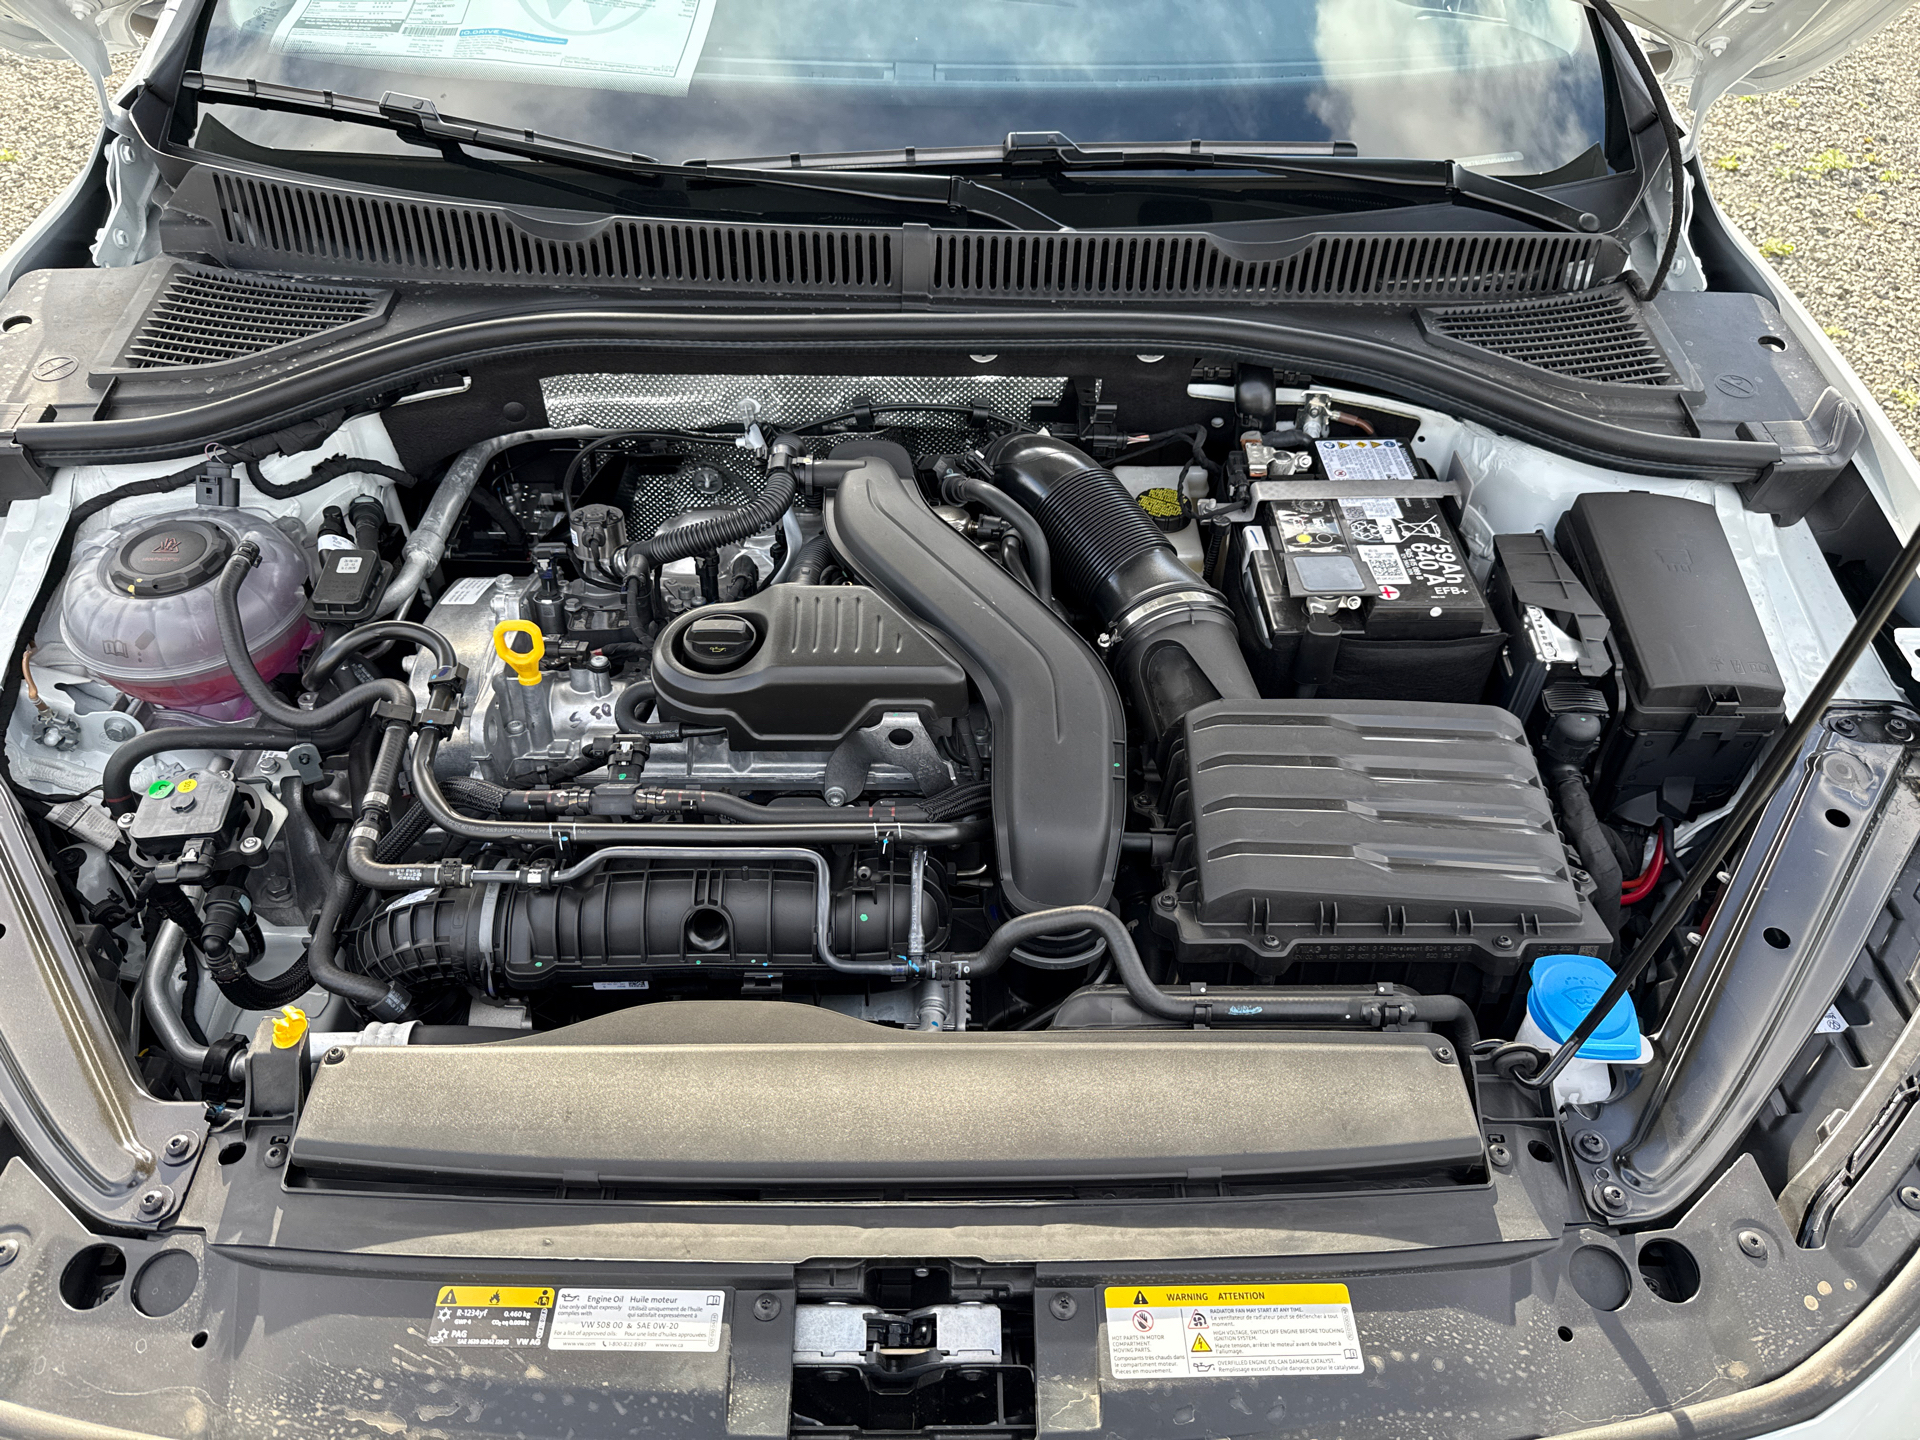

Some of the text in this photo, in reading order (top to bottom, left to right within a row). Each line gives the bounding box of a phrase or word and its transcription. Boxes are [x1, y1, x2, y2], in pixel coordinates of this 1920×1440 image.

[1411, 543, 1439, 570] 640
[1431, 544, 1466, 584] 59Ah
[1423, 574, 1446, 586] A
[1434, 587, 1469, 595] EFB+
[587, 1296, 612, 1304] Engine
[1166, 1291, 1265, 1301] WARNING ATTENTION
[456, 1309, 488, 1319] R-1234yf
[523, 1311, 532, 1319] kg
[596, 1321, 611, 1329] 508
[612, 1321, 623, 1329] 00
[530, 1338, 541, 1346] AG
